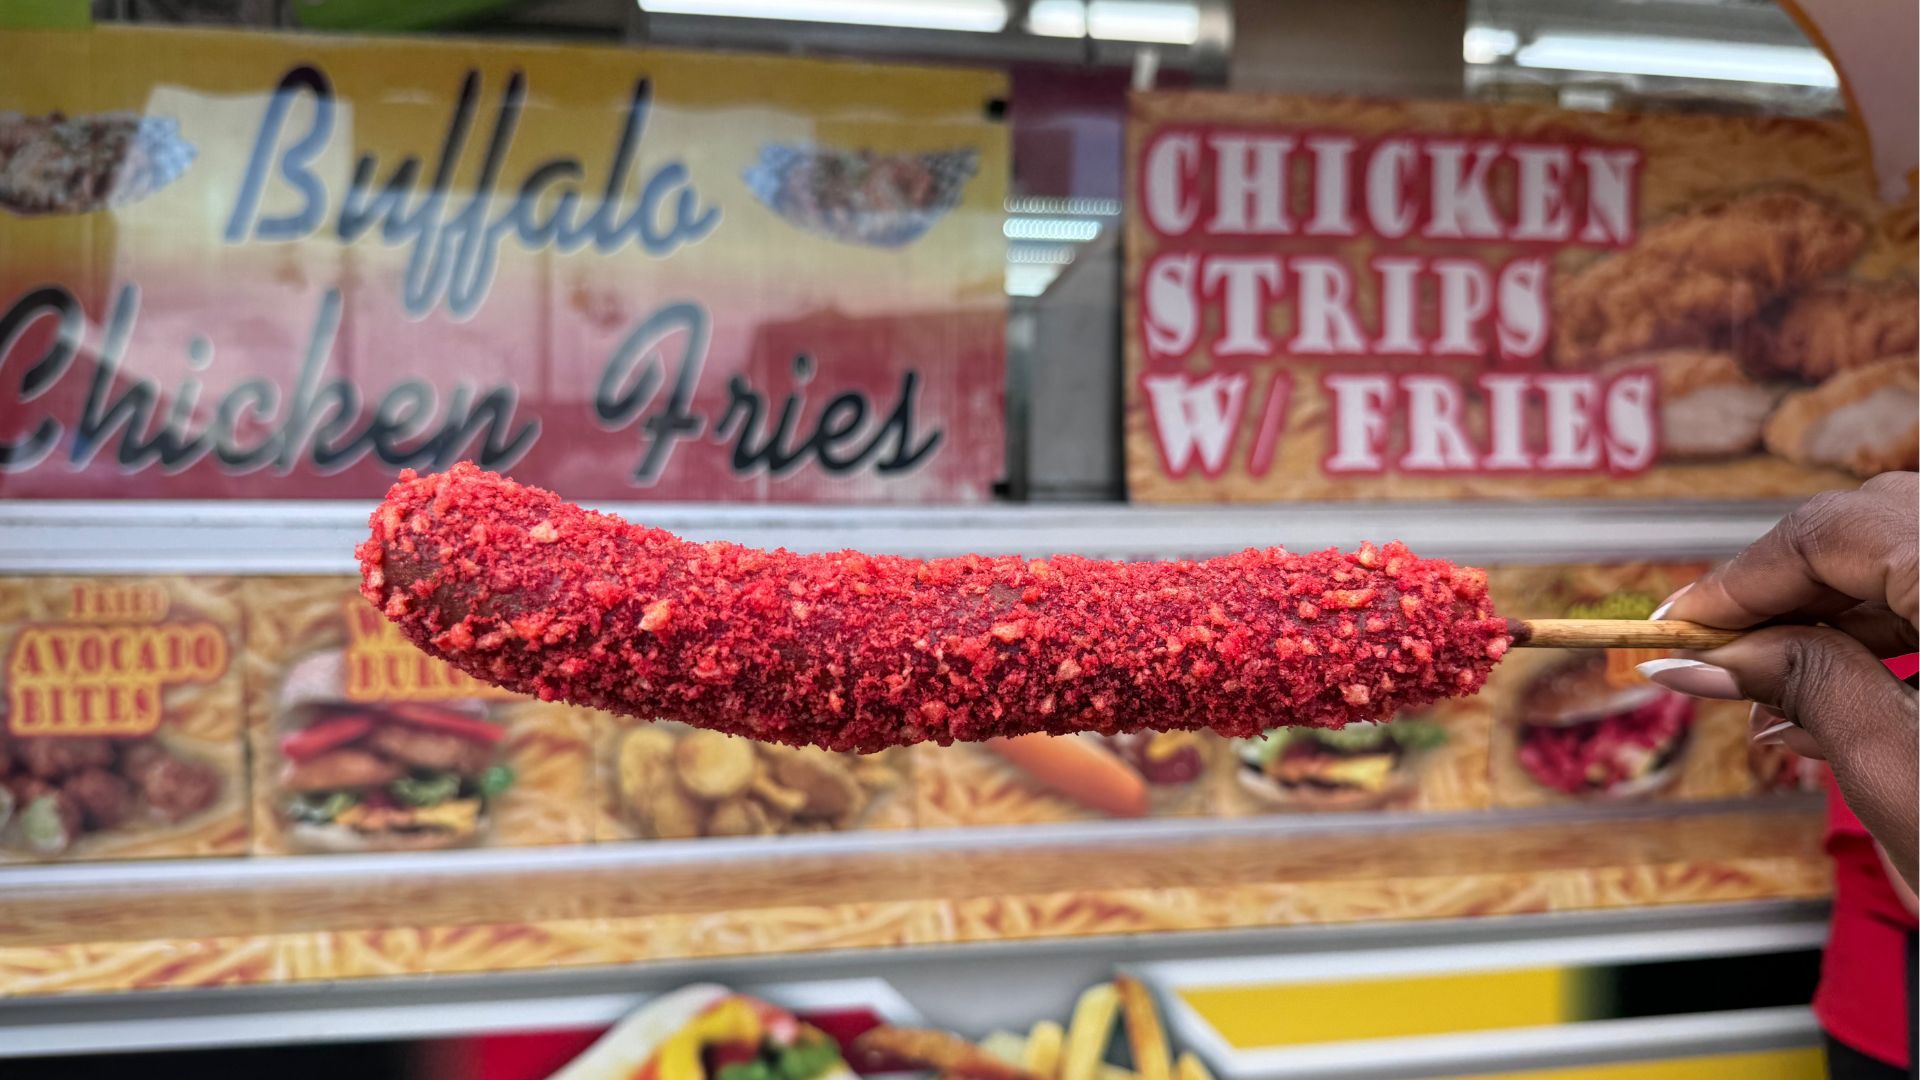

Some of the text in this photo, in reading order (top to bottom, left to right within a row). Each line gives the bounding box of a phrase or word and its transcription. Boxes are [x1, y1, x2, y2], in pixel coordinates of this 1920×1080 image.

[224, 65, 719, 318] Buffalo
[1144, 130, 1640, 244] CHICKEN
[1143, 253, 1549, 357] STRIPS
[0, 284, 942, 485] Chicken Fries
[1144, 371, 1657, 474] W/ FRIES
[20, 634, 216, 675] AVOCADO
[20, 686, 152, 724] BITES
